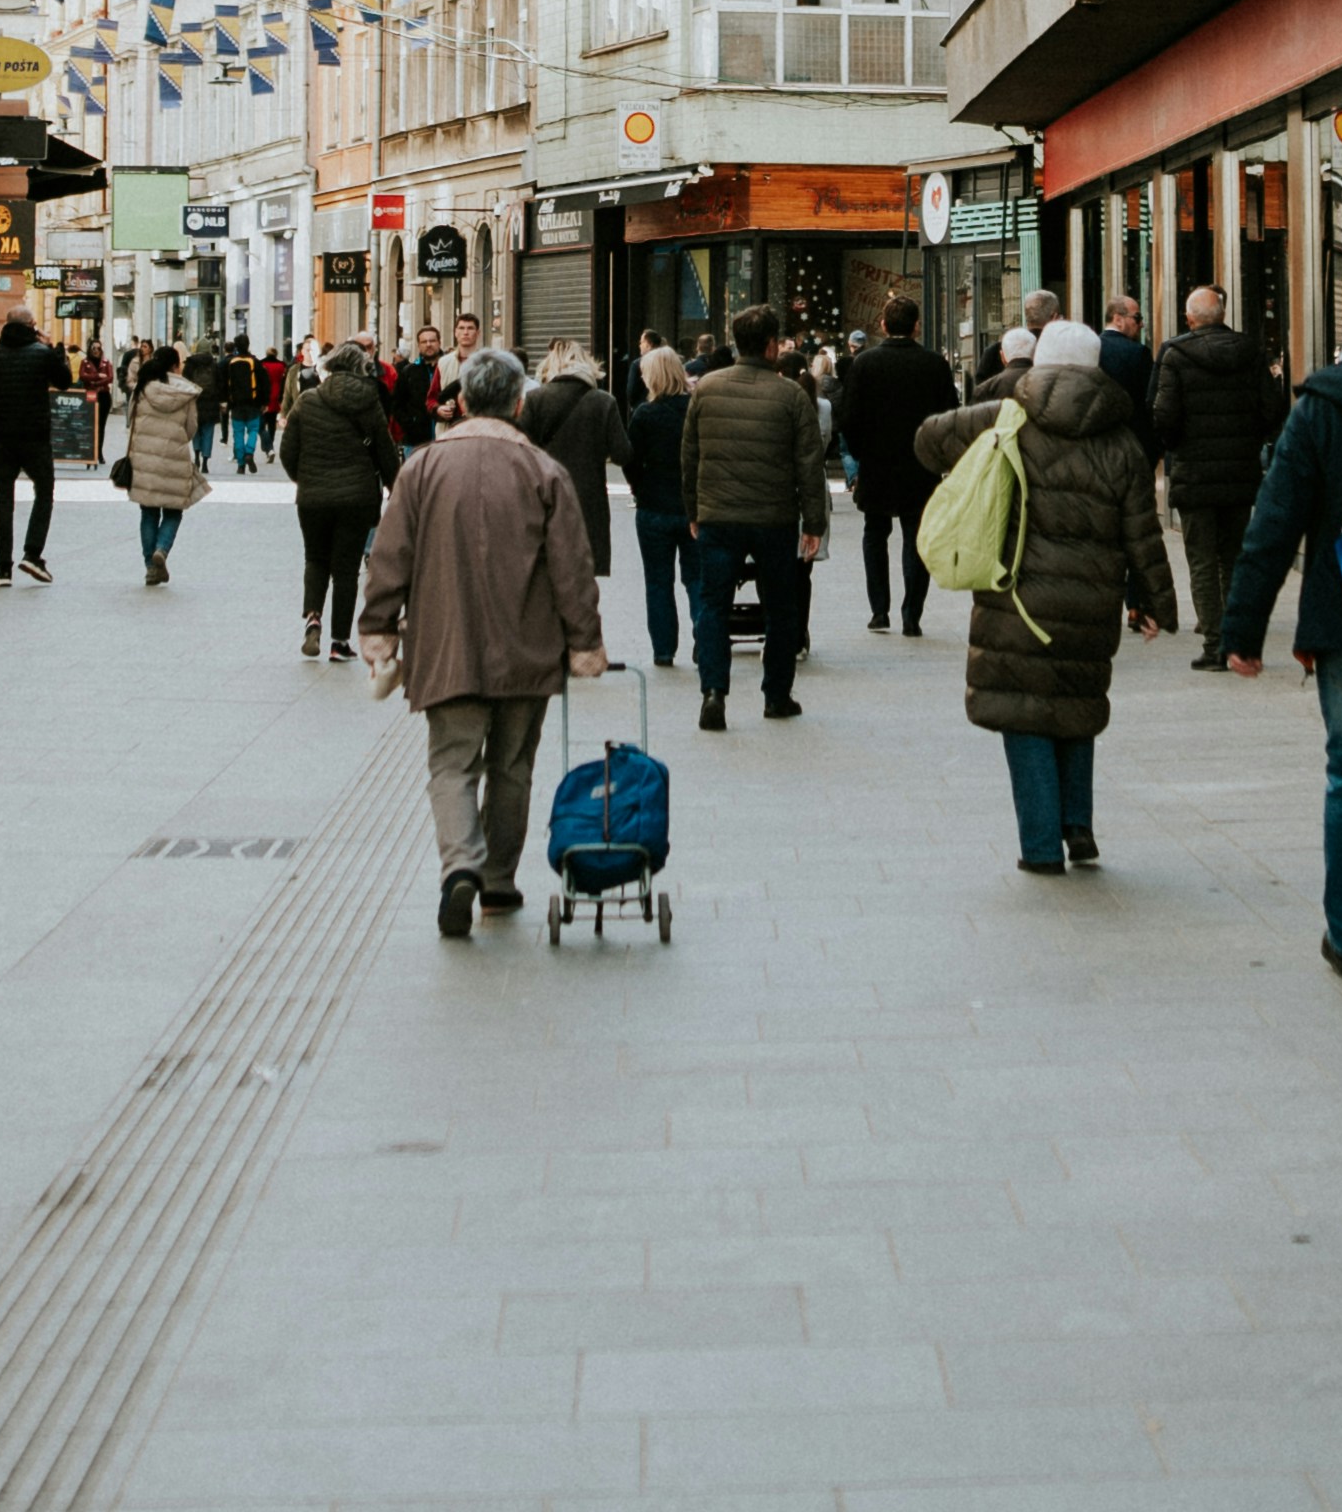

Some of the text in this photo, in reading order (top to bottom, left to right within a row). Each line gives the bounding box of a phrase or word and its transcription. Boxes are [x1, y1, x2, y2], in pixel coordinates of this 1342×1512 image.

[4, 59, 40, 72] POŠTA
[204, 217, 226, 227] NLB
[426, 257, 459, 272] Kaiser
[850, 259, 905, 288] SPRITZ
